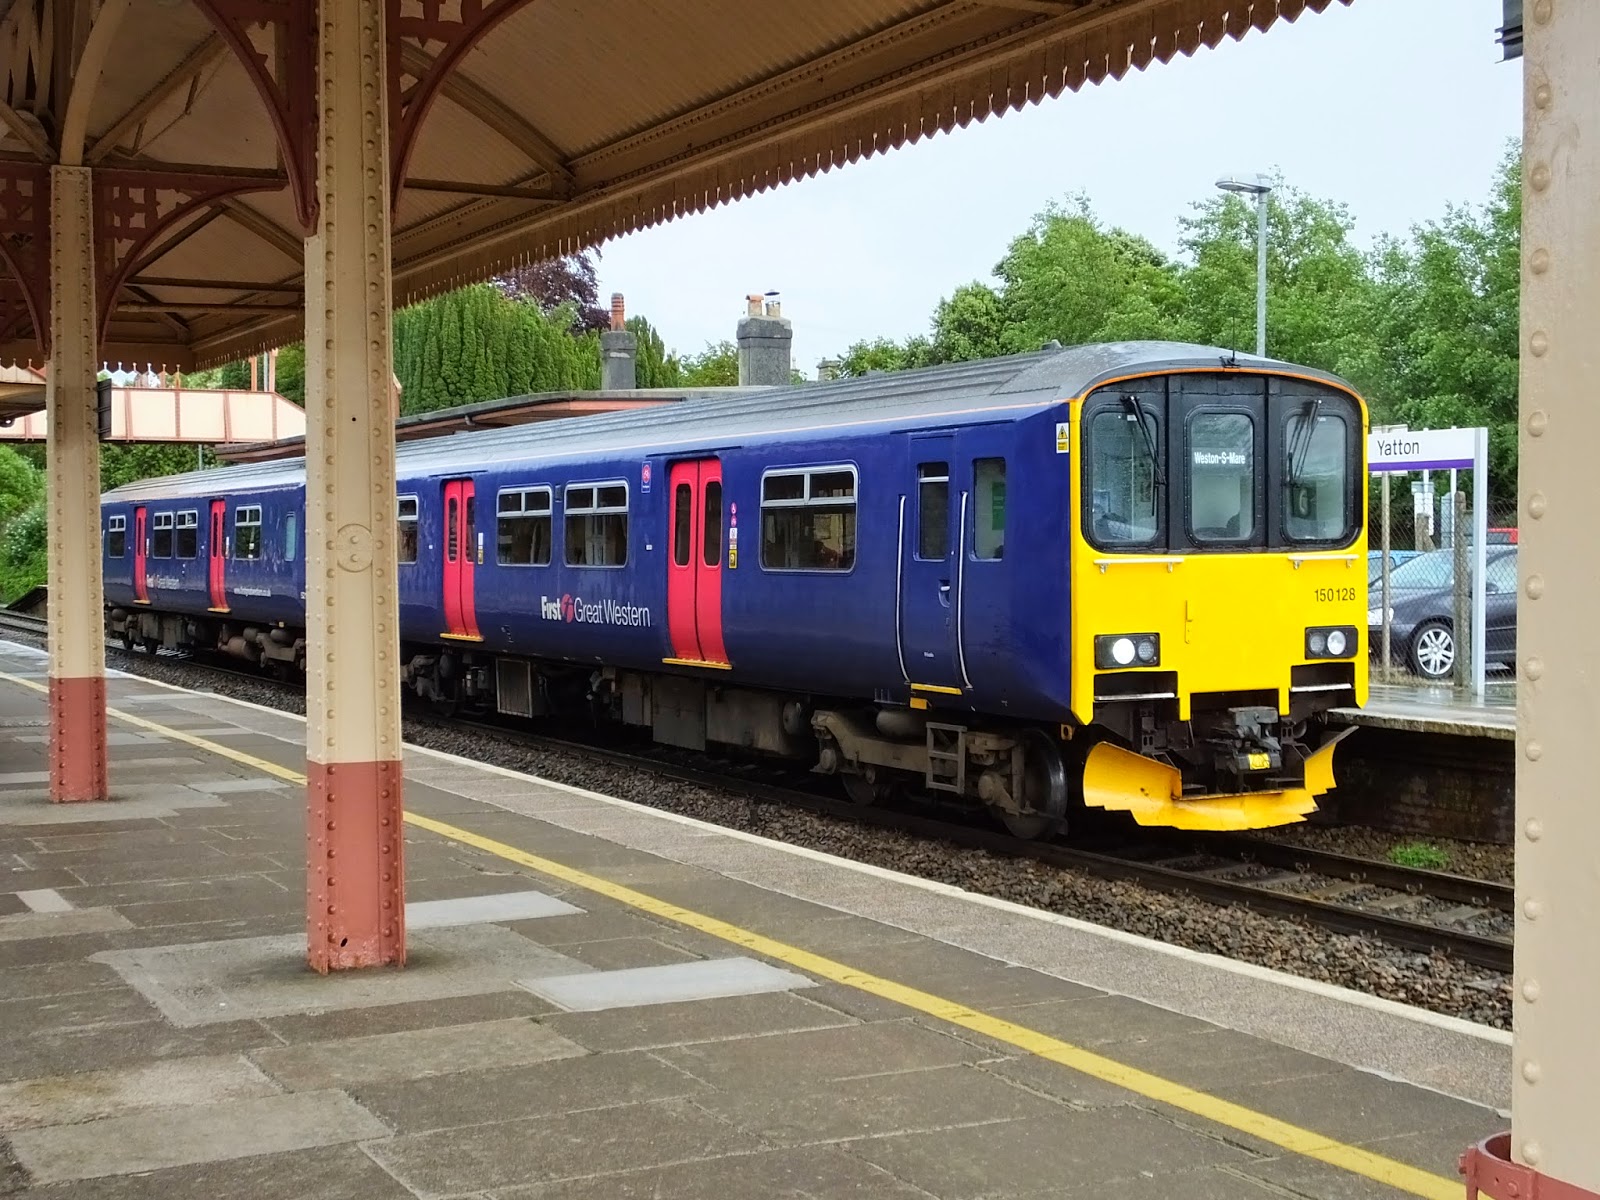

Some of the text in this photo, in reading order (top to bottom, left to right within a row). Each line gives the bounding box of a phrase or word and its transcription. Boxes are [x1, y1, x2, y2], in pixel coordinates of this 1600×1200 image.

[1377, 439, 1420, 456] Yatton
[1194, 451, 1246, 464] Weston-S-Mare
[1314, 587, 1356, 602] 150128
[541, 596, 651, 628] First Great Western
